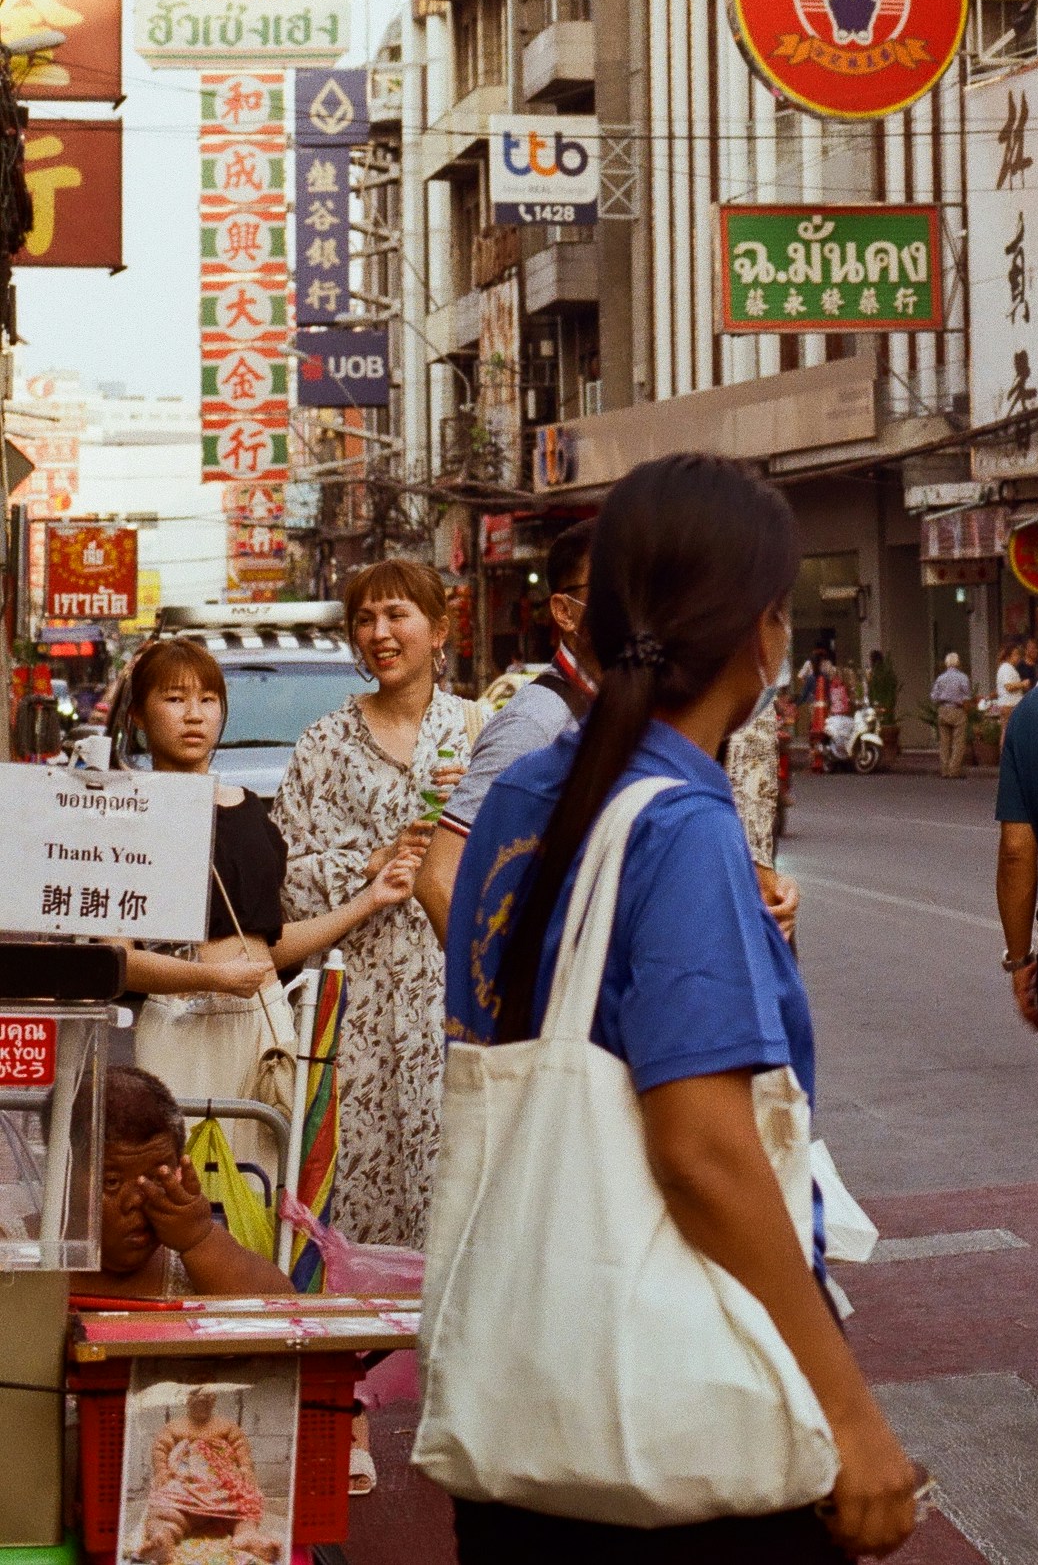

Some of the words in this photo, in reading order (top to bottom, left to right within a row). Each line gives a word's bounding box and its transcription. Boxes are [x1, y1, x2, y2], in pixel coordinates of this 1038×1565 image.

[502, 131, 589, 177] ttb
[533, 205, 576, 222] 1428
[733, 214, 928, 284] ฉ.มั่นคง
[220, 80, 267, 472] 和成興大金行
[328, 355, 385, 379] UOB
[55, 788, 150, 817] ขอบคุณค่ะ
[44, 842, 104, 863] Thank
[110, 846, 153, 866] You.
[41, 884, 149, 922] 謝謝你
[13, 1047, 46, 1061] YOU
